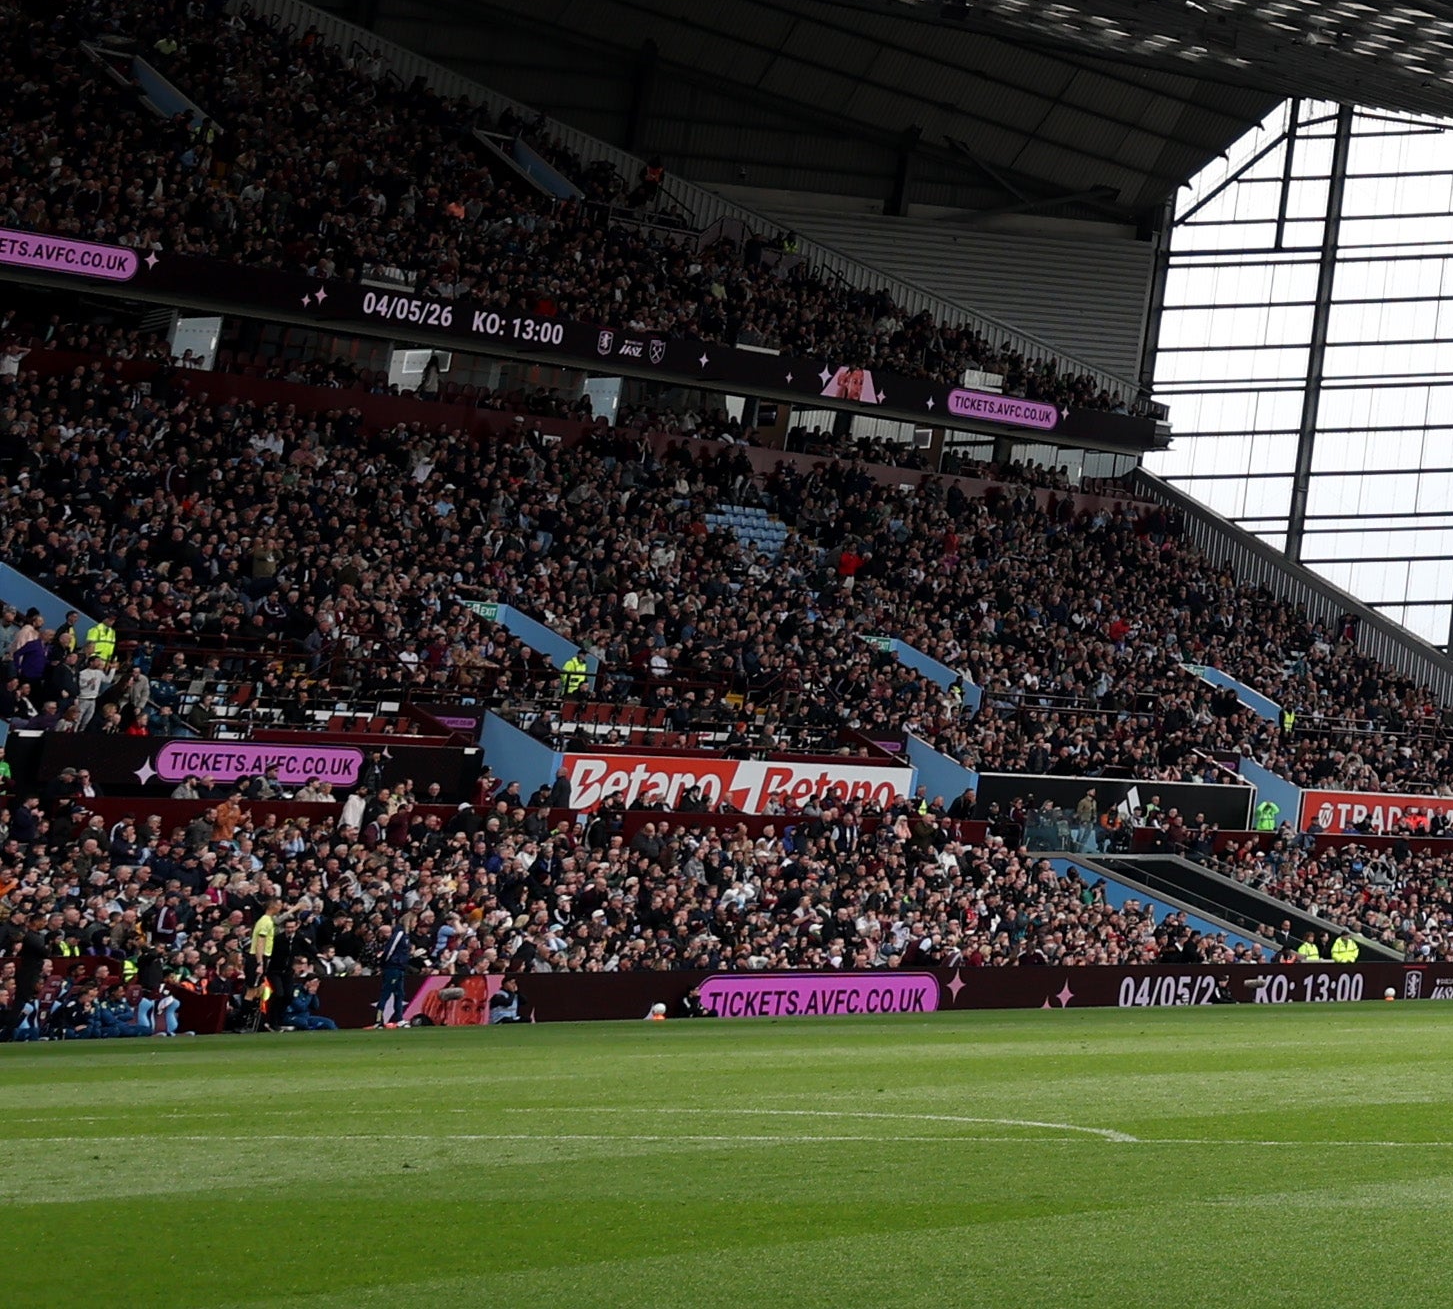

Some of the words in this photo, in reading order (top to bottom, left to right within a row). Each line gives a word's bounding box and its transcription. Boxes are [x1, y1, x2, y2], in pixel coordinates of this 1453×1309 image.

[363, 292, 453, 327] 04/05/26
[472, 310, 506, 337] KO:
[512, 318, 564, 345] 13:00
[955, 394, 1053, 423] TICKETS.AVFC.CO.UK
[170, 751, 356, 776] TICKETS.AVFC.CO.UK
[568, 759, 722, 811] Betano
[757, 766, 898, 812] Betano
[1337, 803, 1420, 836] TRAD
[708, 987, 928, 1018] TICKETS.AVFC.CO.UK
[1119, 975, 1216, 1008] 04/05/2
[1255, 973, 1296, 1004] KO:
[1303, 972, 1365, 1004] 13:00
